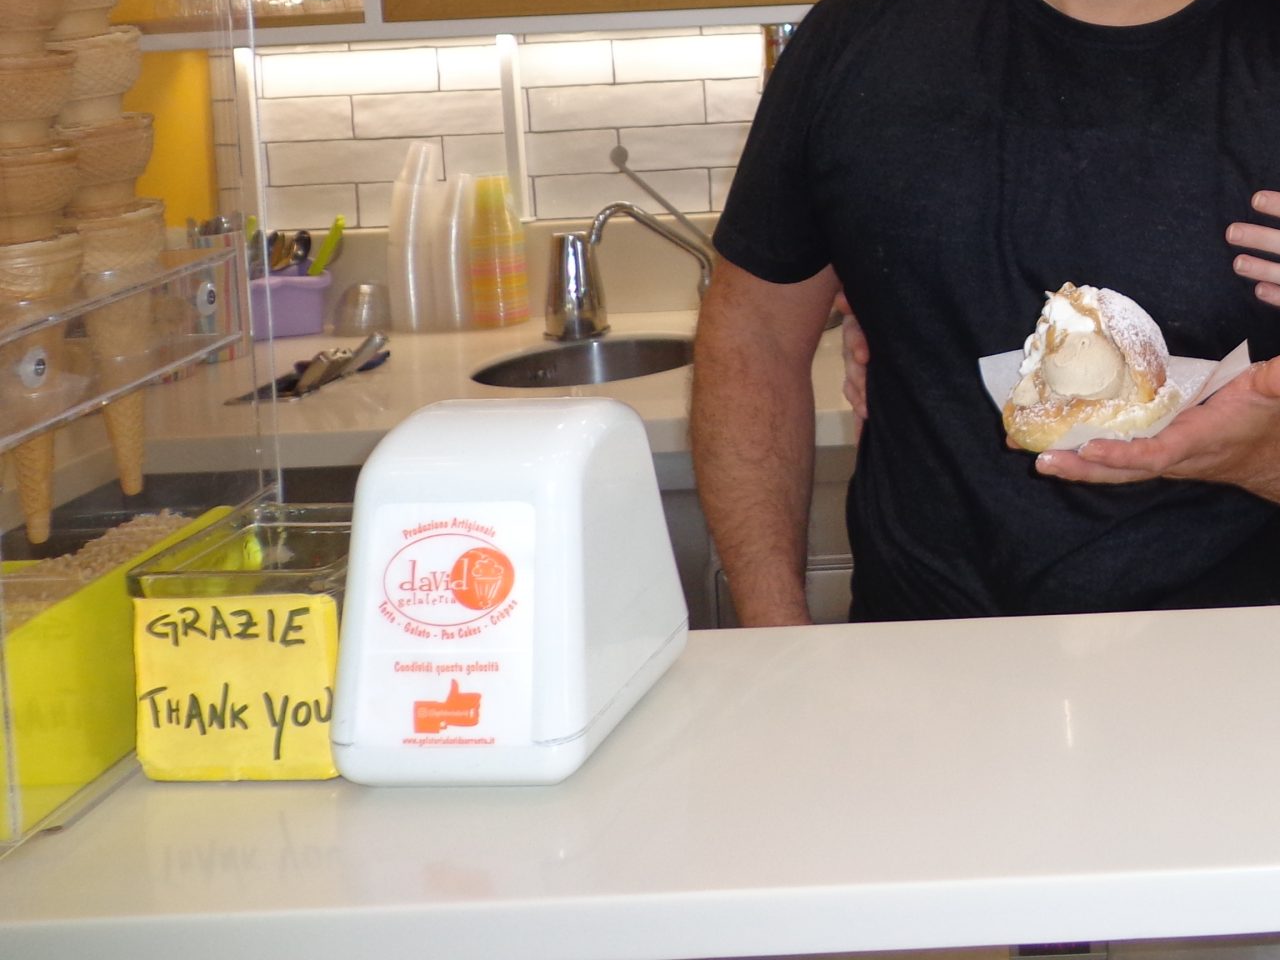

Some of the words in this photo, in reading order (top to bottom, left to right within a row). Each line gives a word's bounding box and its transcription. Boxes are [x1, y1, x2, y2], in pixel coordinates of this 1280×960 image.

[398, 592, 457, 608] gelateria
[145, 605, 311, 647] GRAZIE
[139, 682, 249, 735] THANK
[263, 686, 334, 761] YOU
